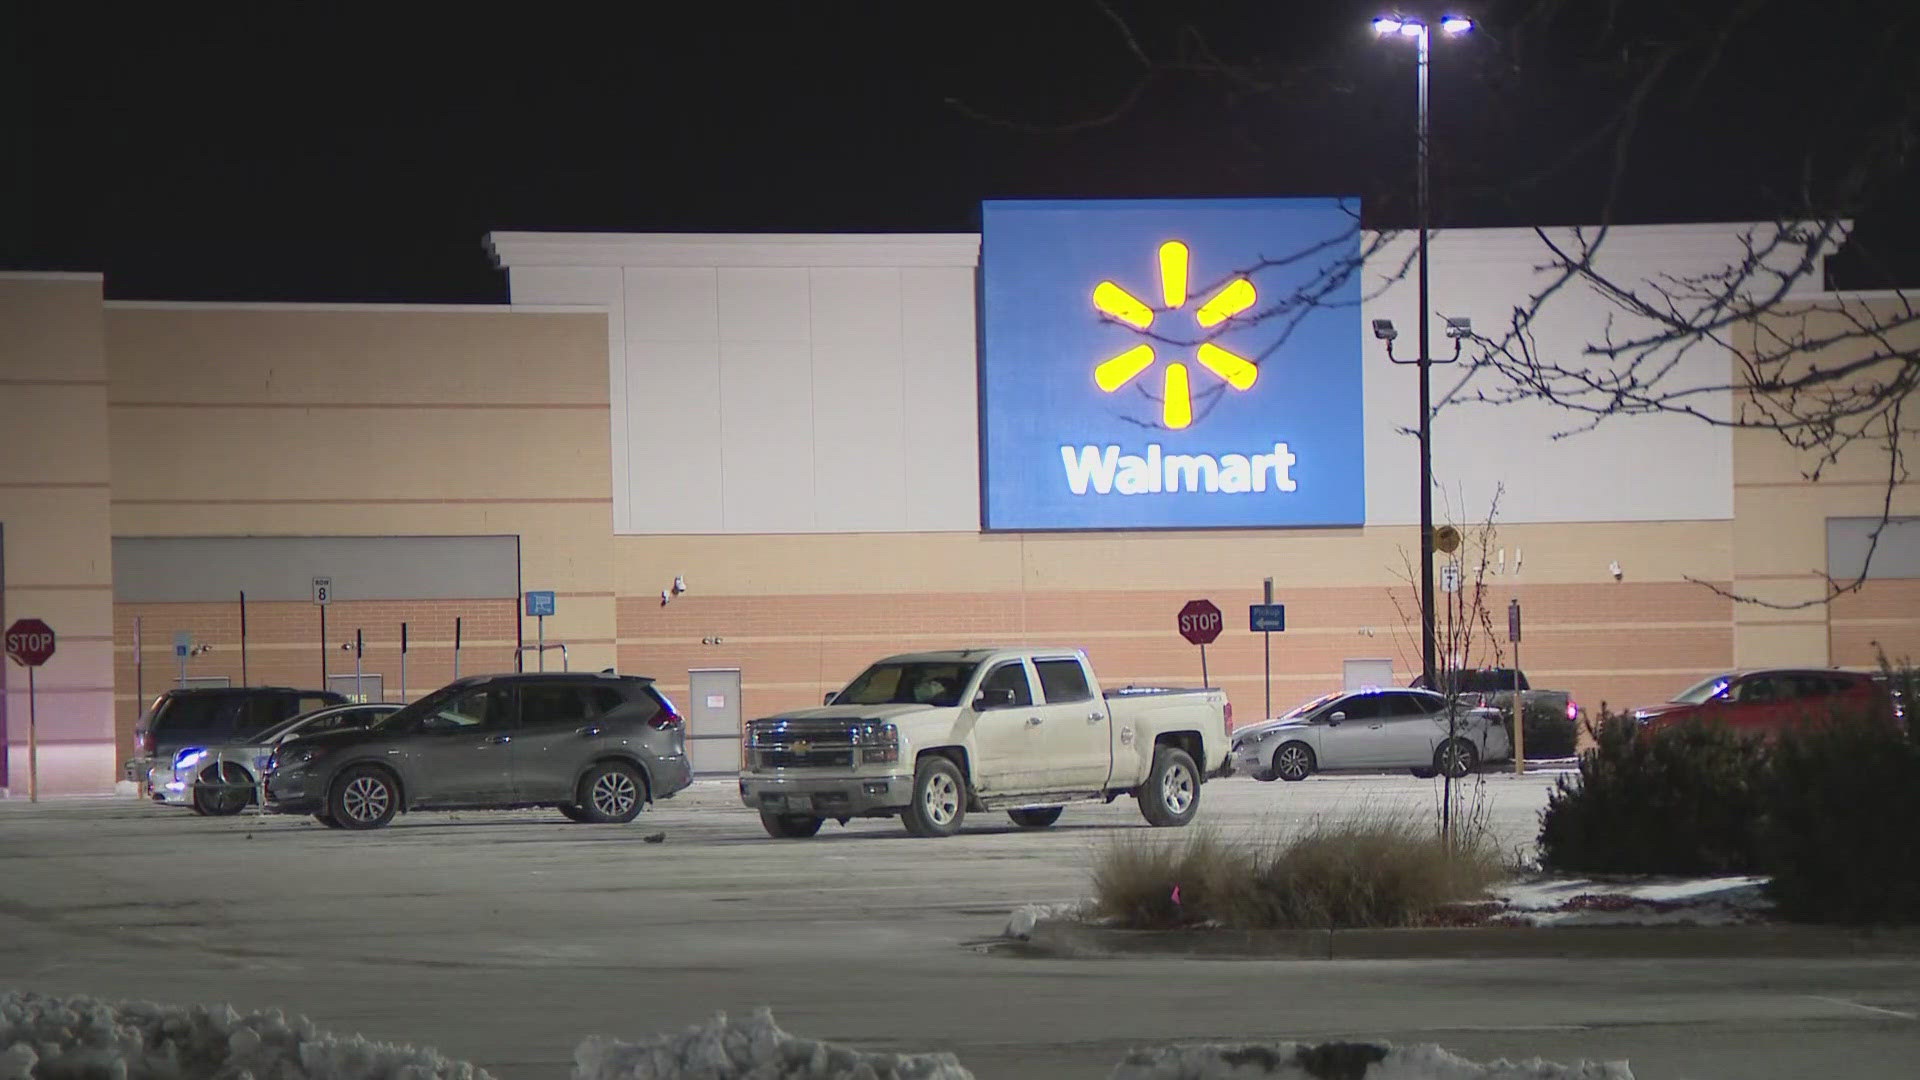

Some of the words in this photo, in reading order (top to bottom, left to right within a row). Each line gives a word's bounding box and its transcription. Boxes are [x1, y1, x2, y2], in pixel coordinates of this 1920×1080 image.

[1060, 442, 1297, 495] Walmart
[318, 587, 326, 601] 8
[1253, 607, 1280, 618] Pickup
[1181, 612, 1220, 633] STOP
[8, 634, 52, 652] STOP
